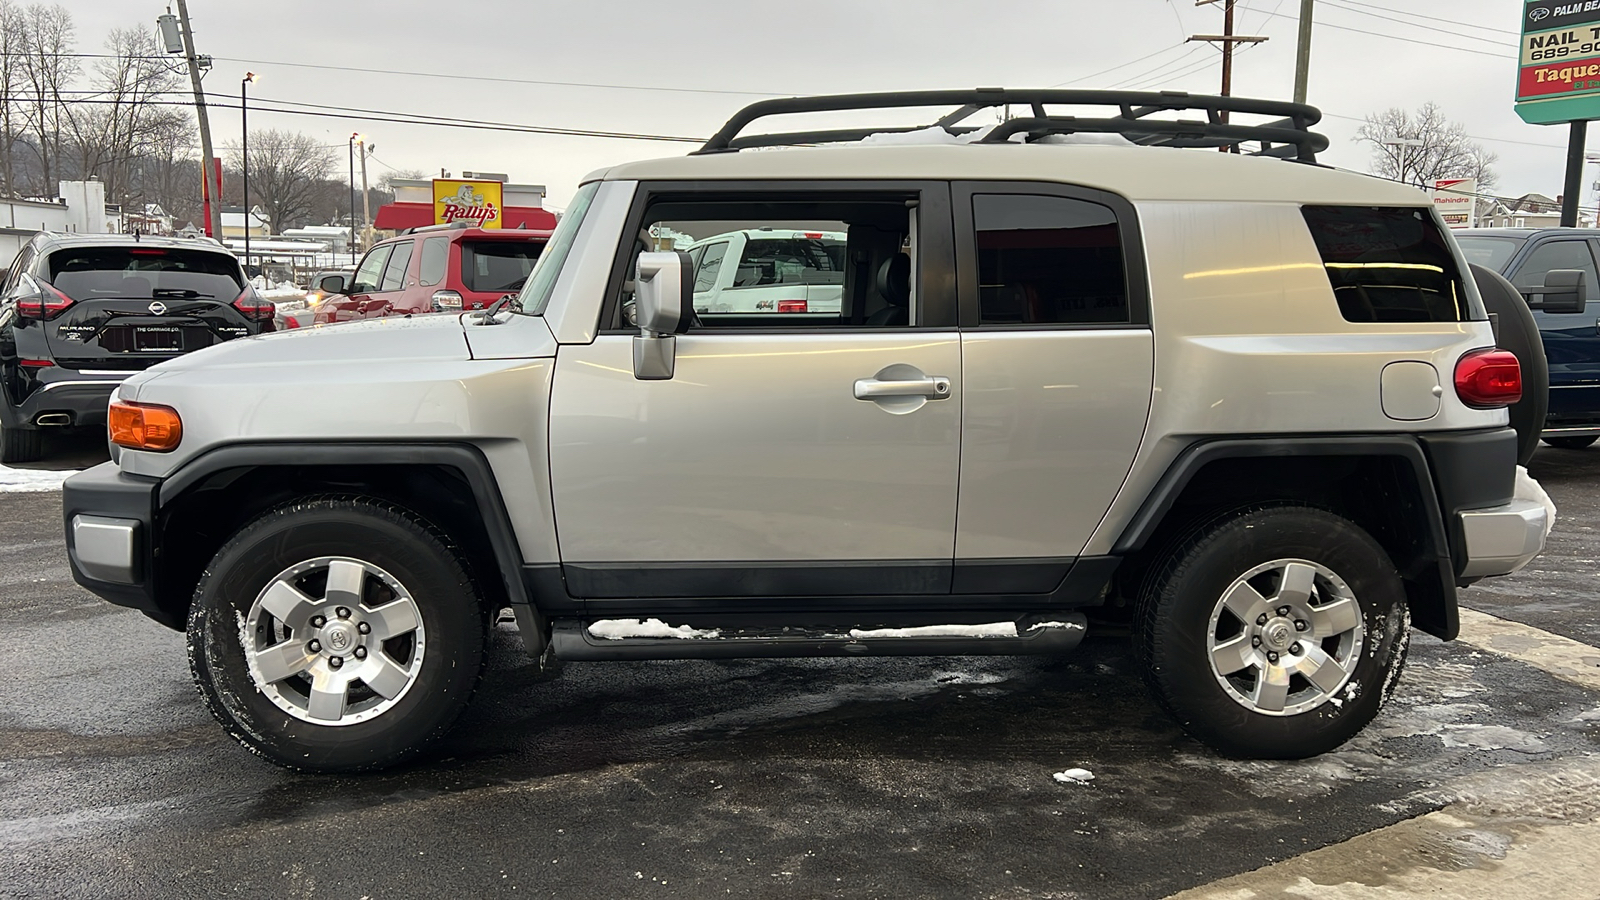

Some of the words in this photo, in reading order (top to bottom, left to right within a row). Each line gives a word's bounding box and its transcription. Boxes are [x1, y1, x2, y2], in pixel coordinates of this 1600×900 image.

[1553, 2, 1583, 17] PALM
[1530, 31, 1580, 49] NAIL
[1535, 63, 1600, 83] Taque
[441, 202, 497, 227] Rally's
